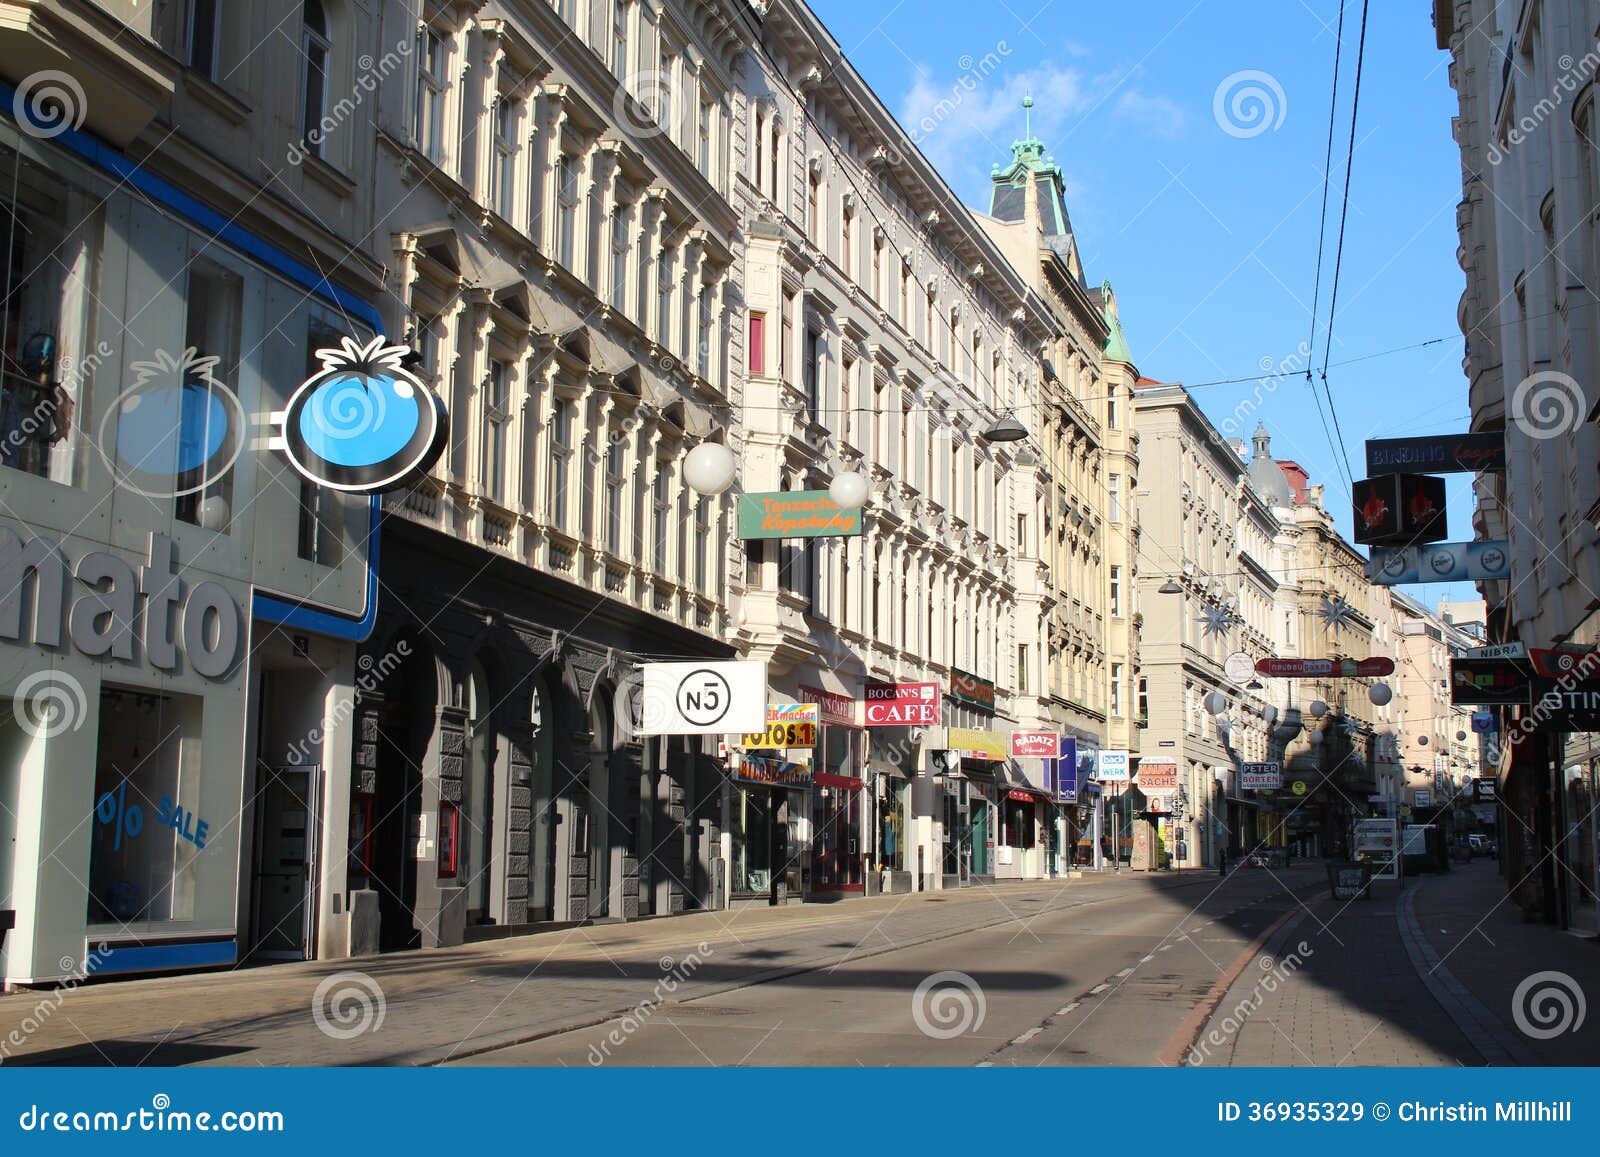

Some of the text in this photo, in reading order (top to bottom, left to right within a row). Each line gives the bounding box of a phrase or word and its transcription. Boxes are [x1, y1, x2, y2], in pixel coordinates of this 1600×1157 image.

[1481, 645, 1519, 658] NIBRA
[868, 688, 918, 699] BOCAN'S
[867, 698, 935, 722] CAFÉ
[1015, 735, 1055, 748] RADATZ
[1243, 765, 1277, 773] PETER
[1140, 777, 1176, 786] SACHE
[154, 794, 210, 849] SALE
